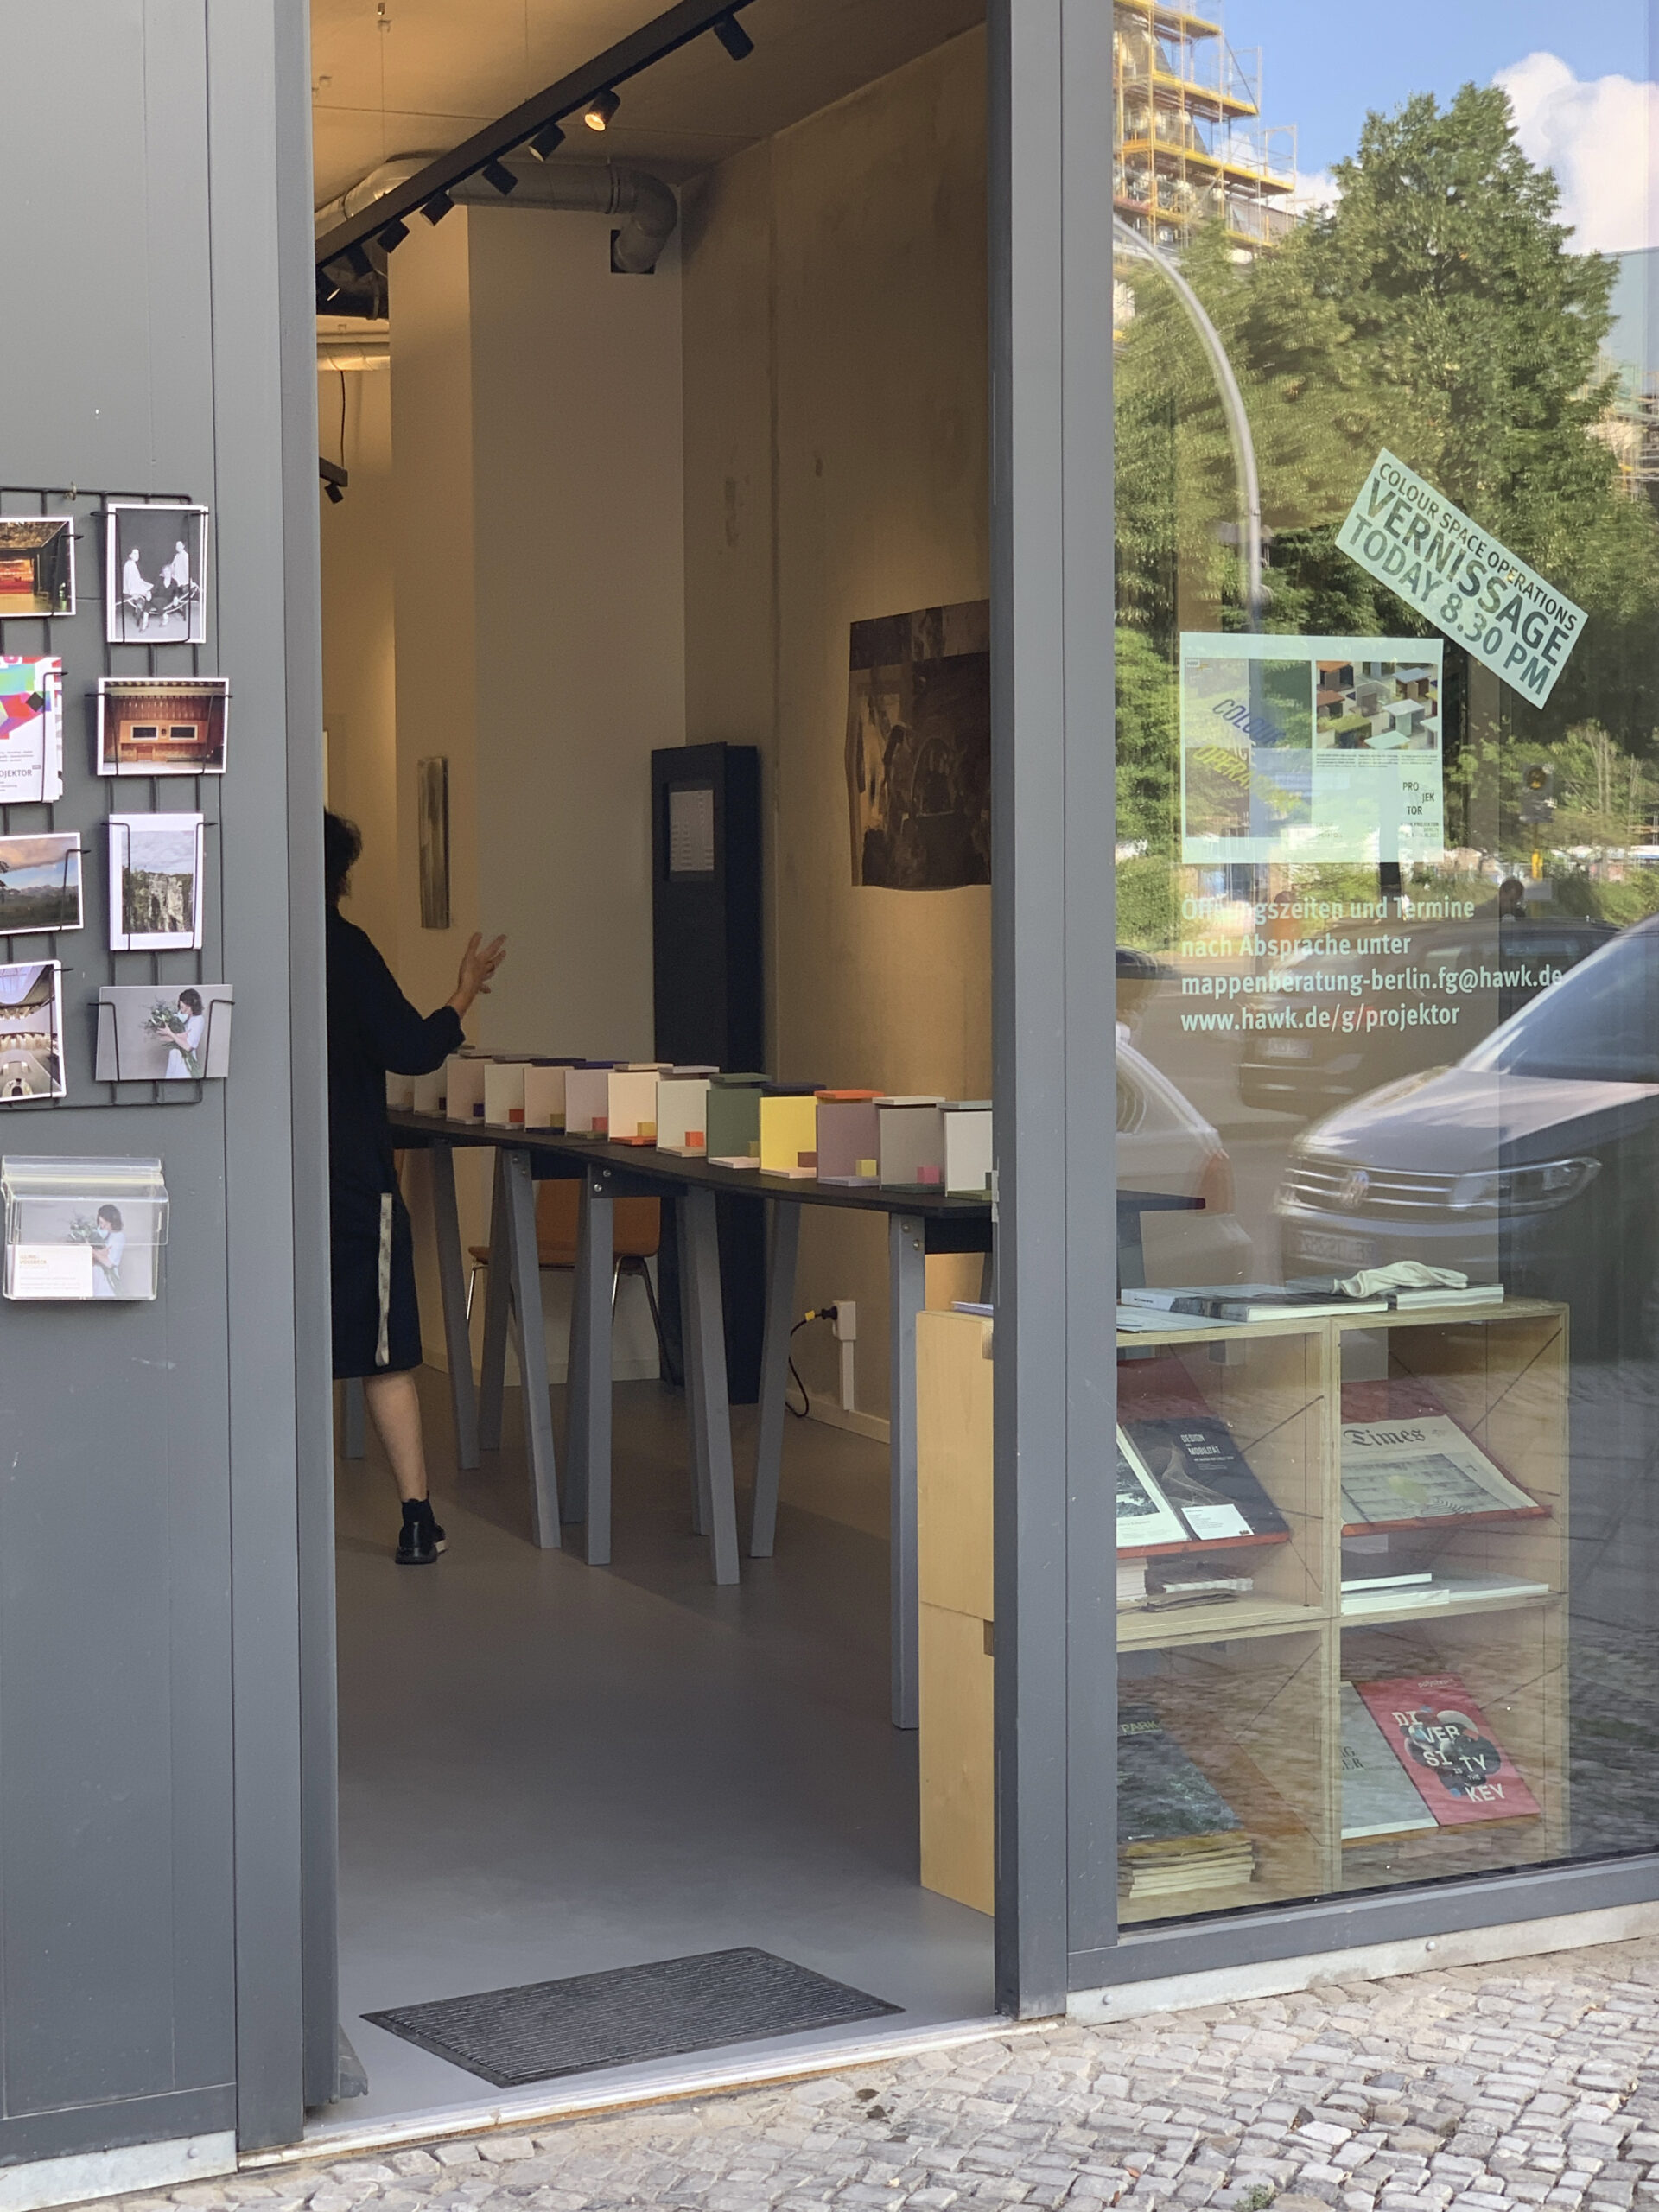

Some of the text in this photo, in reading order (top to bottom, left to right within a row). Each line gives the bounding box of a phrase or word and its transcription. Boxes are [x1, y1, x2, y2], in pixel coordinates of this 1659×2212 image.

[1379, 462, 1578, 632] COLOUR SPACE OPERATIONS
[1367, 476, 1570, 667] VERNISSAGE
[1349, 512, 1551, 696] TODAY 8.30 PM
[1402, 781, 1420, 791] PRO
[1421, 792, 1435, 804] JEK
[1407, 805, 1423, 816] TOR
[1181, 893, 1476, 925] Öffgszeiten und Termine
[1181, 932, 1412, 961] nach Absprache unter
[1181, 963, 1563, 1000] mappenberatung-berlin.fg@hawk.de
[1180, 1002, 1459, 1033] www.hawk.de/g/projektor
[1343, 1428, 1426, 1446] Times
[1464, 1783, 1506, 1802] KEY
